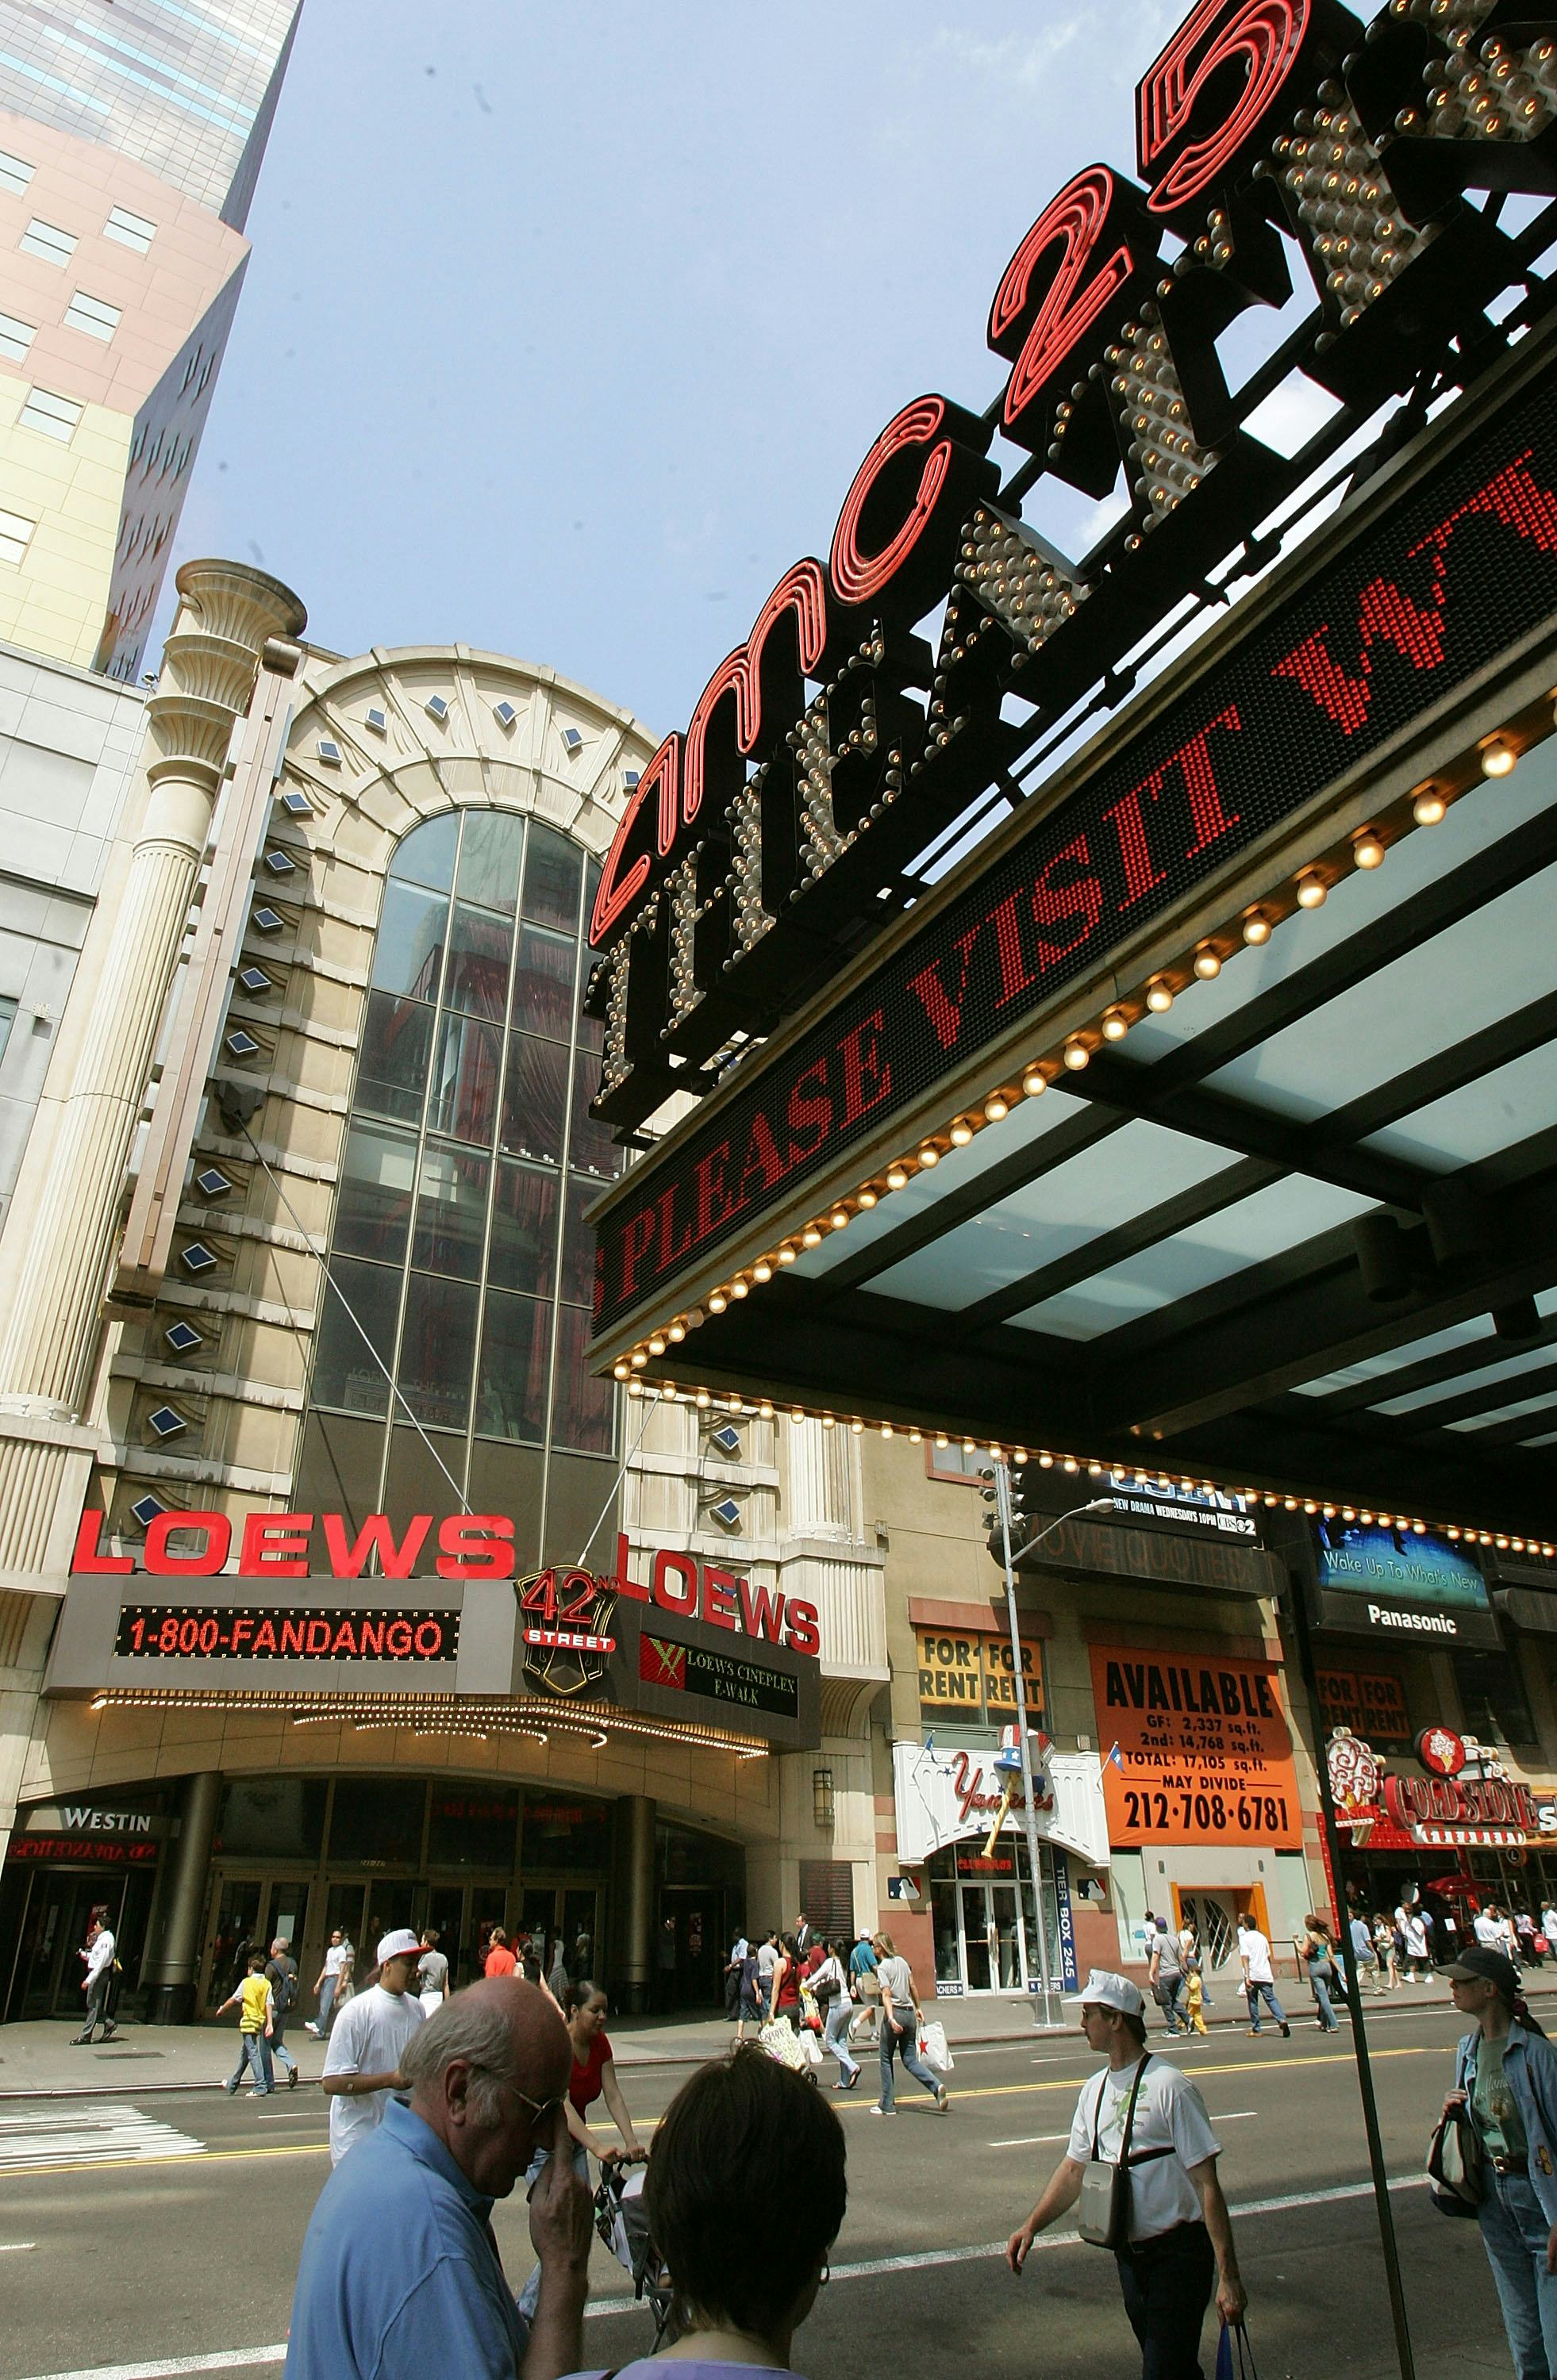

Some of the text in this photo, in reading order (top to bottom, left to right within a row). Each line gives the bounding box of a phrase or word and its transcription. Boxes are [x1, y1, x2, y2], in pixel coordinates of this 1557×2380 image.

[989, 0, 1313, 426] 25
[618, 1008, 892, 1301] PLEASE
[905, 703, 1243, 1050] VISIT
[1113, 1497, 1128, 1511] NEW
[1130, 1500, 1155, 1515] DRAMA
[1155, 1505, 1198, 1523] WEDNESDAYS
[1199, 1512, 1217, 1526] 10PM
[71, 1508, 516, 1580] LOEWS
[1323, 1550, 1478, 1590] Wake Up To What's New
[612, 1531, 821, 1656] LOEWS
[1367, 1603, 1457, 1634] Panasonic
[129, 1617, 443, 1656] 1-800-FANDANGO
[529, 1630, 611, 1649] STREET
[925, 1637, 971, 1667] FOR
[989, 1643, 1034, 1673] FOR
[737, 1664, 795, 1694] CINEPLEX
[919, 1668, 978, 1699] RENT
[985, 1674, 1040, 1704] RENT
[1106, 1661, 1274, 1718] AVAILABLE
[1319, 1676, 1353, 1701] FOR
[1364, 1681, 1397, 1705] FOR
[1147, 1714, 1261, 1737] GF: 2,337 sq.ft.
[1366, 1707, 1409, 1732] RENT
[1140, 1732, 1265, 1755] 2nd: 14,768 sq.ft.
[1125, 1751, 1267, 1774] TOTAL: 17,105 sq.ft.
[1163, 1774, 1247, 1791] MAY DIVIDE
[1390, 1775, 1539, 1831] COLD STONE
[63, 1807, 151, 1832] WESTIN
[1055, 1866, 1075, 1978] TIER BOX 245
